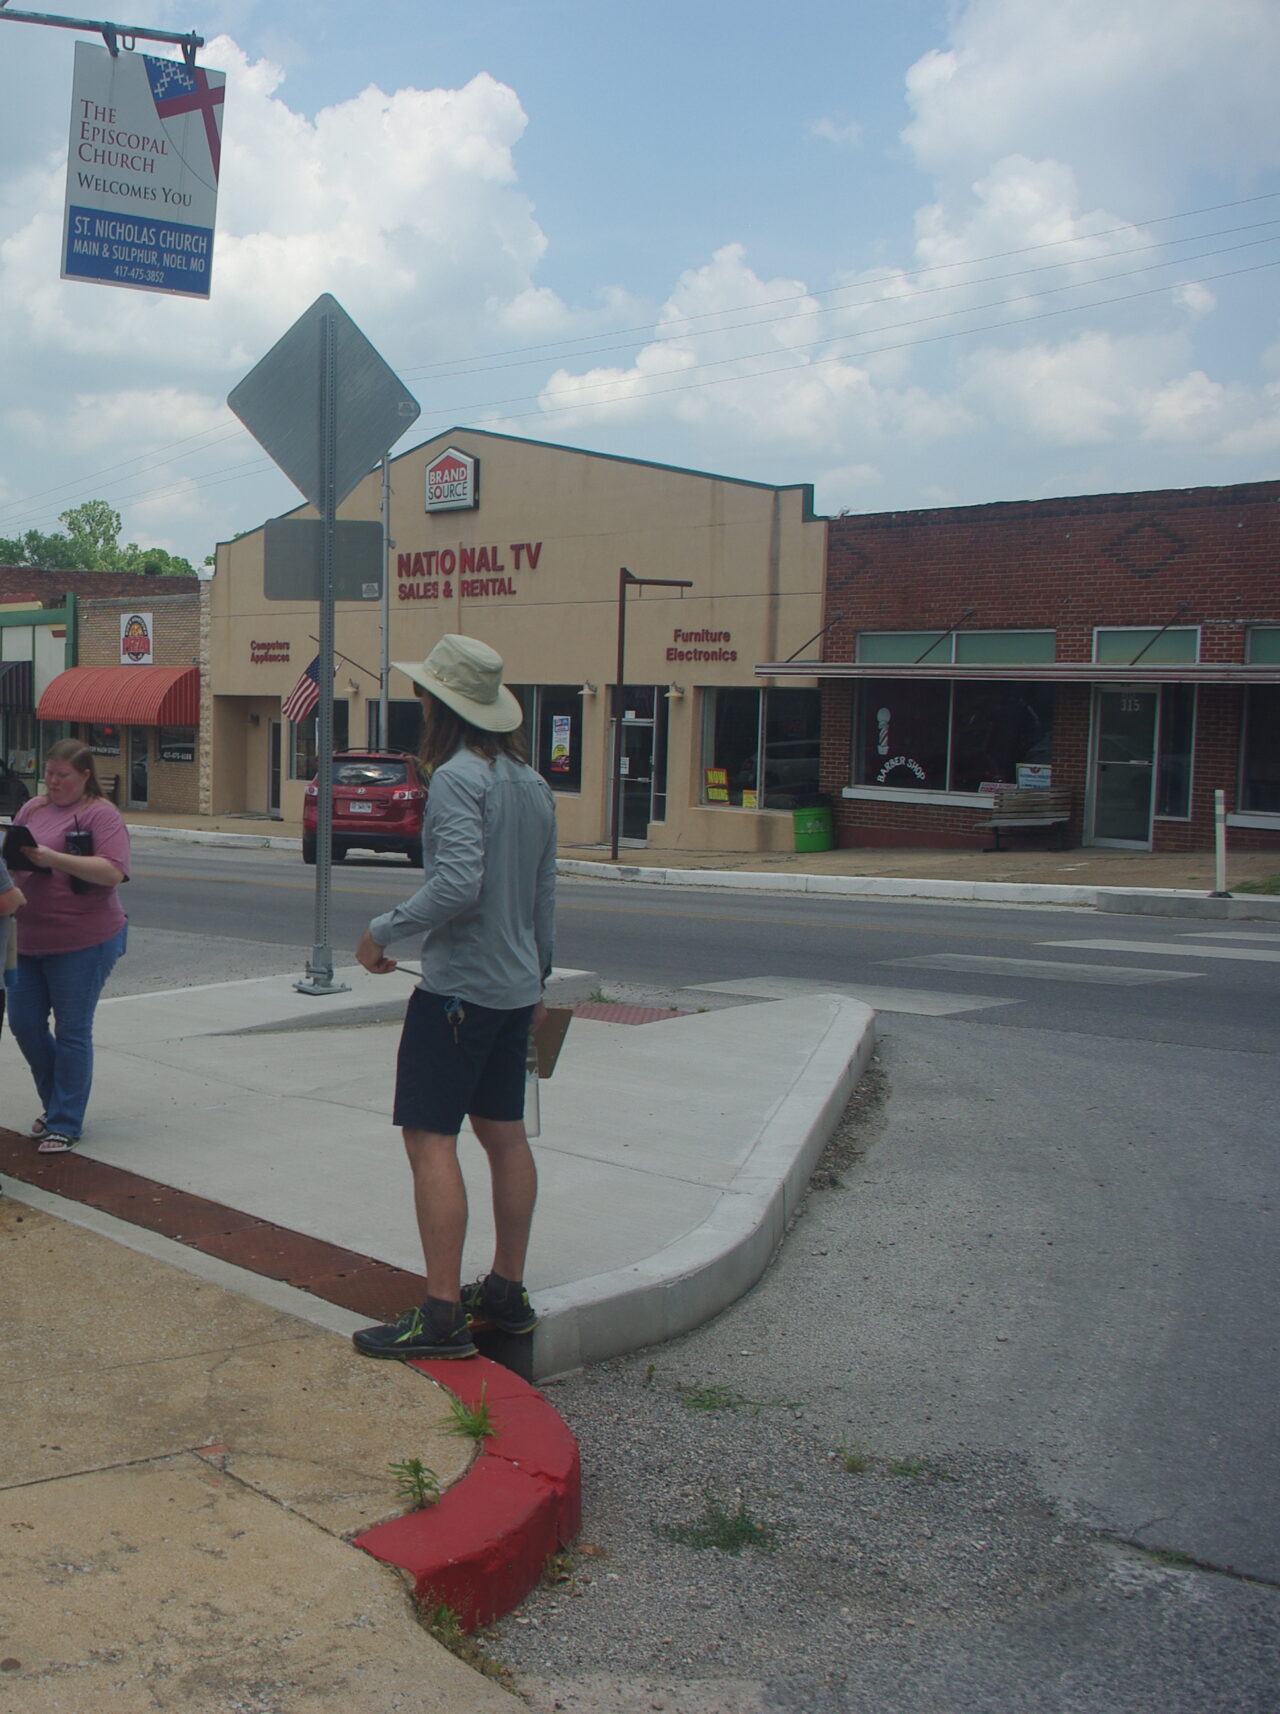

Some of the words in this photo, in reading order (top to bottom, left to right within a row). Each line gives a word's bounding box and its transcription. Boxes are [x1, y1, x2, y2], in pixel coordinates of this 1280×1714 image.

[80, 99, 116, 124] THE
[80, 121, 169, 156] EPISCOPAL
[77, 143, 155, 174] CHURCH
[77, 172, 157, 201] WELCOMES
[162, 187, 192, 207] YOU
[74, 215, 91, 237] ST.
[95, 218, 156, 245] NICHOLAS
[159, 229, 208, 254] CHURCH
[73, 239, 99, 256] MAIN
[101, 243, 110, 257] &
[111, 244, 160, 268] SULPHUR,
[162, 253, 188, 269] NOEL
[190, 257, 205, 273] MO
[429, 467, 467, 484] BRAND
[428, 481, 468, 500] SOURCE
[397, 545, 505, 578] NATIONAL
[510, 541, 543, 570] TV
[397, 580, 439, 601] SALES
[442, 580, 453, 598] &
[459, 576, 517, 598] RENTAL
[250, 640, 290, 654] Computers
[673, 628, 732, 644] Furniture
[250, 651, 290, 665] Appliances
[665, 646, 738, 662] Electronics
[1120, 698, 1140, 712] 315
[876, 755, 906, 784] BARBER
[906, 758, 926, 781] SHOP
